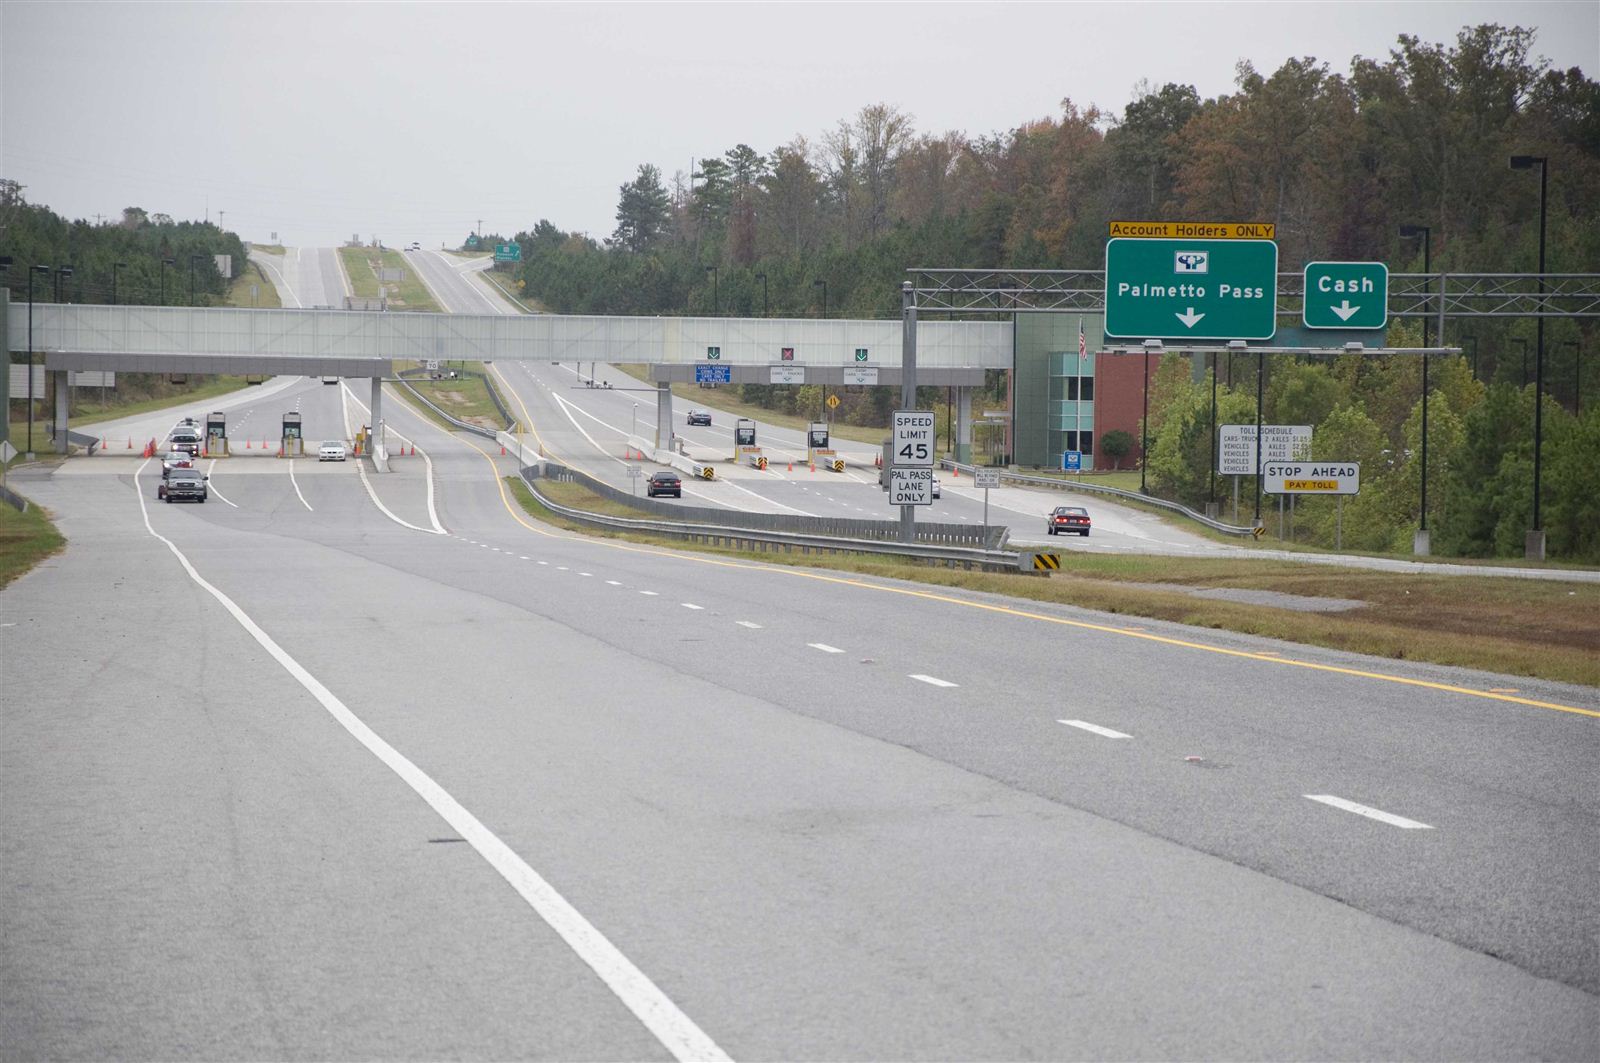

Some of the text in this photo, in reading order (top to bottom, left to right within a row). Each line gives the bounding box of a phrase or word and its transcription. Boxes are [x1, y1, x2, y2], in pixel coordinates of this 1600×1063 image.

[1112, 224, 1273, 237] Account Holders ONLY
[1318, 275, 1374, 293] Cash
[1118, 283, 1264, 299] Palmetto Pass
[896, 417, 932, 427] SPEED
[900, 430, 928, 440] LIMIT
[1240, 427, 1293, 435] TOLL SCHEDULE
[899, 443, 929, 460] 45
[891, 471, 931, 480] PAL PASS
[1269, 467, 1355, 477] STOP AHEAD
[898, 482, 923, 491] LANE
[1289, 481, 1307, 489] PAY
[896, 493, 925, 502] ONLY
